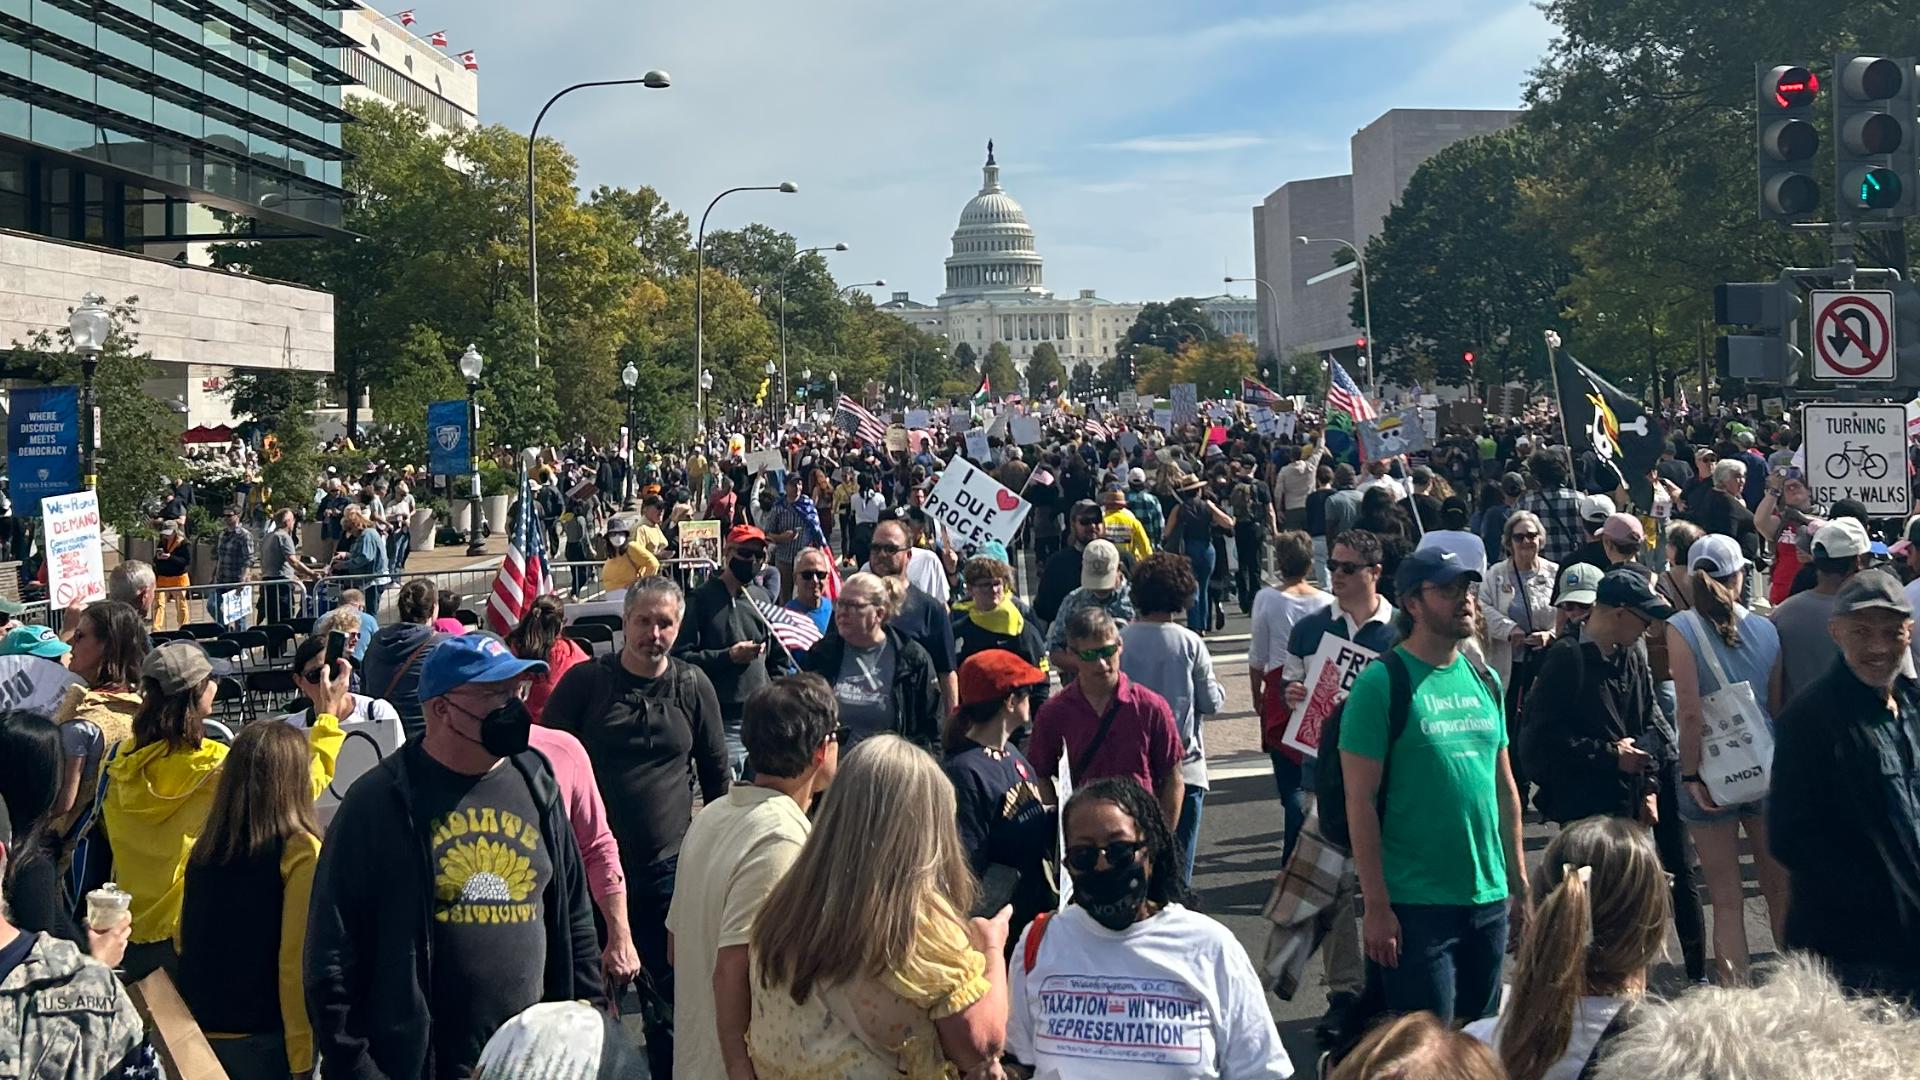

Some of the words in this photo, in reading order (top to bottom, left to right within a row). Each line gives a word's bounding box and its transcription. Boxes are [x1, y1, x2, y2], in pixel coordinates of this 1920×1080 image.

[29, 411, 57, 421] WHERE
[20, 423, 65, 434] DISCOVERY
[1825, 417, 1886, 434] TURNING
[29, 434, 56, 444] MEETS
[18, 446, 67, 457] DEMOCRACY
[962, 468, 975, 485] I
[1844, 486, 1905, 503] X-WALKS
[955, 489, 997, 525] DUE
[53, 512, 98, 534] DEMAND
[1724, 769, 1753, 784] AMD
[43, 996, 71, 1010] U.S.
[75, 994, 118, 1009] ARMY
[1041, 993, 1109, 1016] TAXATION
[1127, 998, 1197, 1021] WITHOUT
[1047, 1018, 1184, 1045] REPRESENTATION
